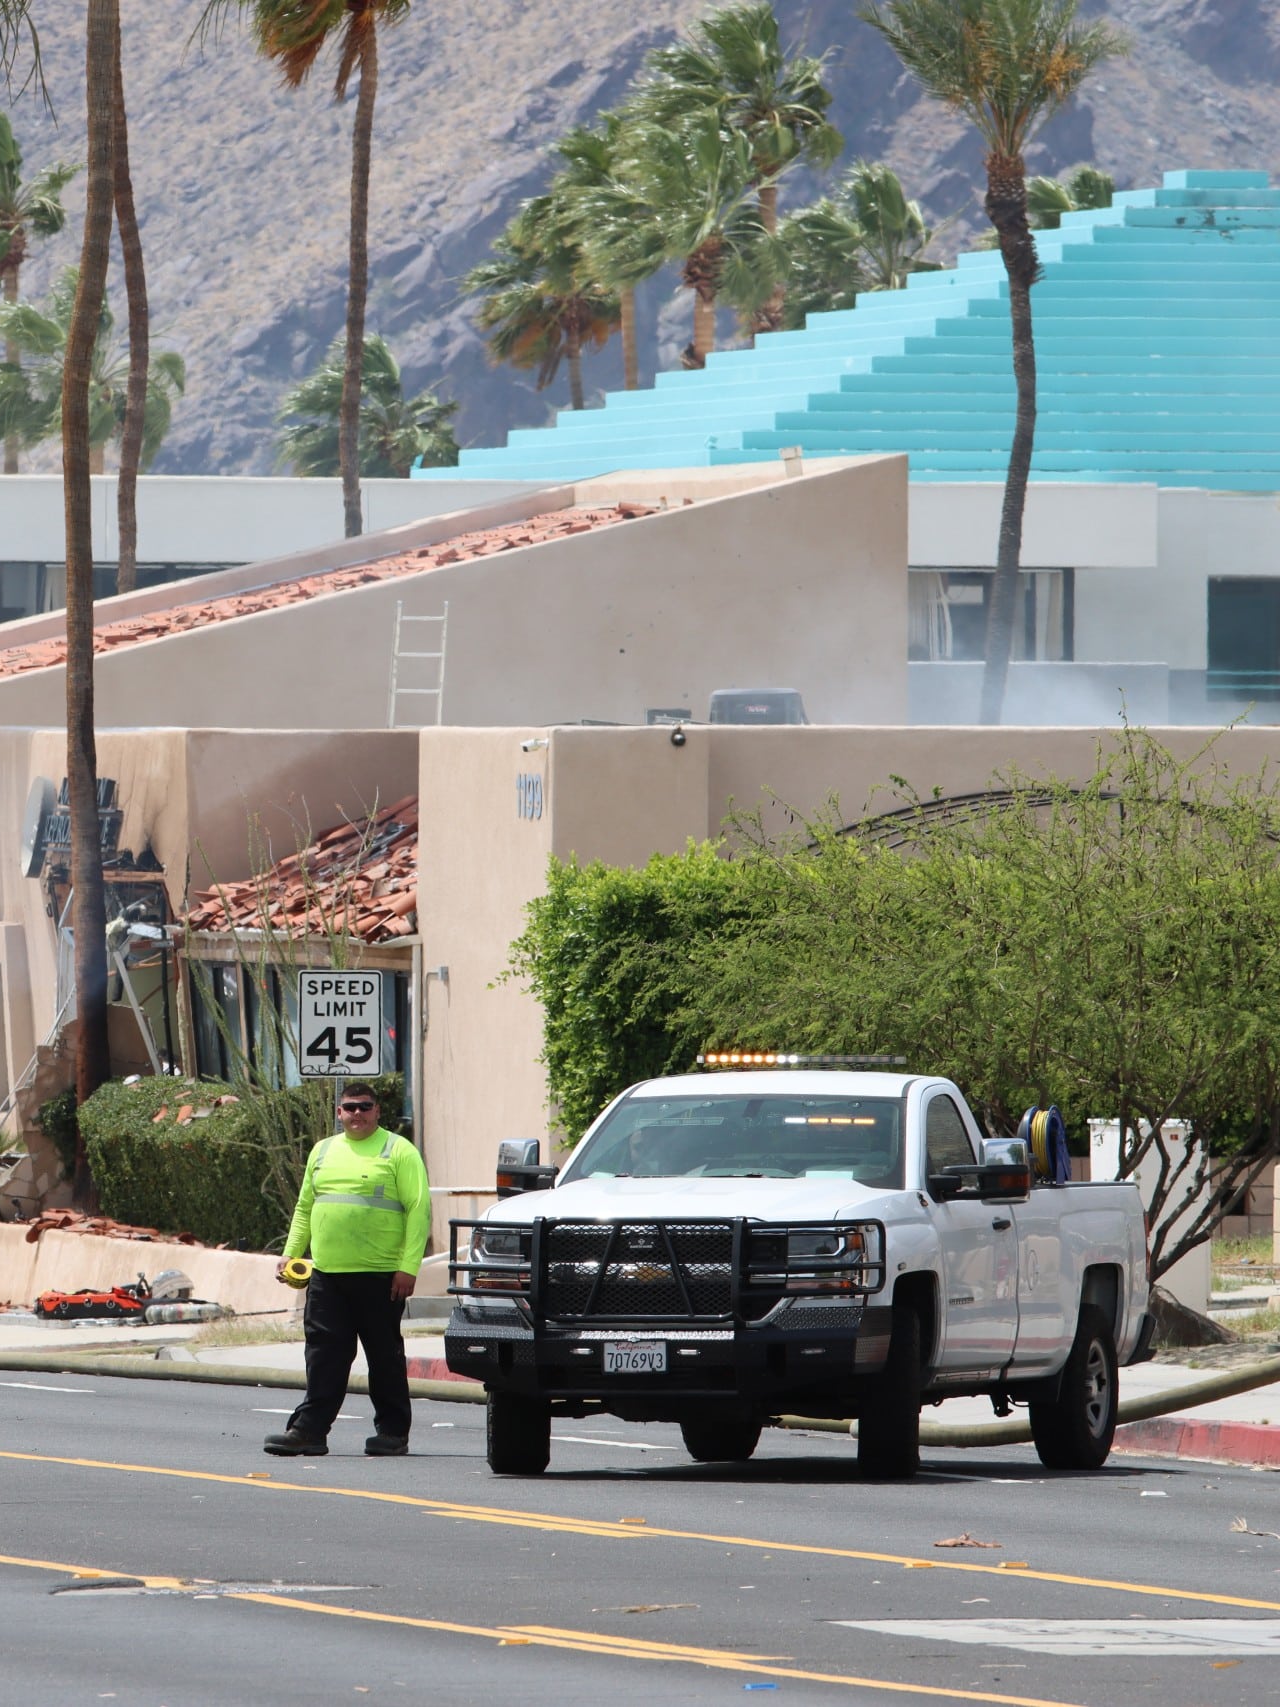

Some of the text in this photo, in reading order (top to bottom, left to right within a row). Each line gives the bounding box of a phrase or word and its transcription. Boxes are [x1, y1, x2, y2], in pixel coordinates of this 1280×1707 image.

[307, 980, 374, 996] SPEED
[314, 1001, 366, 1017] LIMIT
[306, 1026, 373, 1064] 45
[607, 1353, 664, 1368] 70769V3
